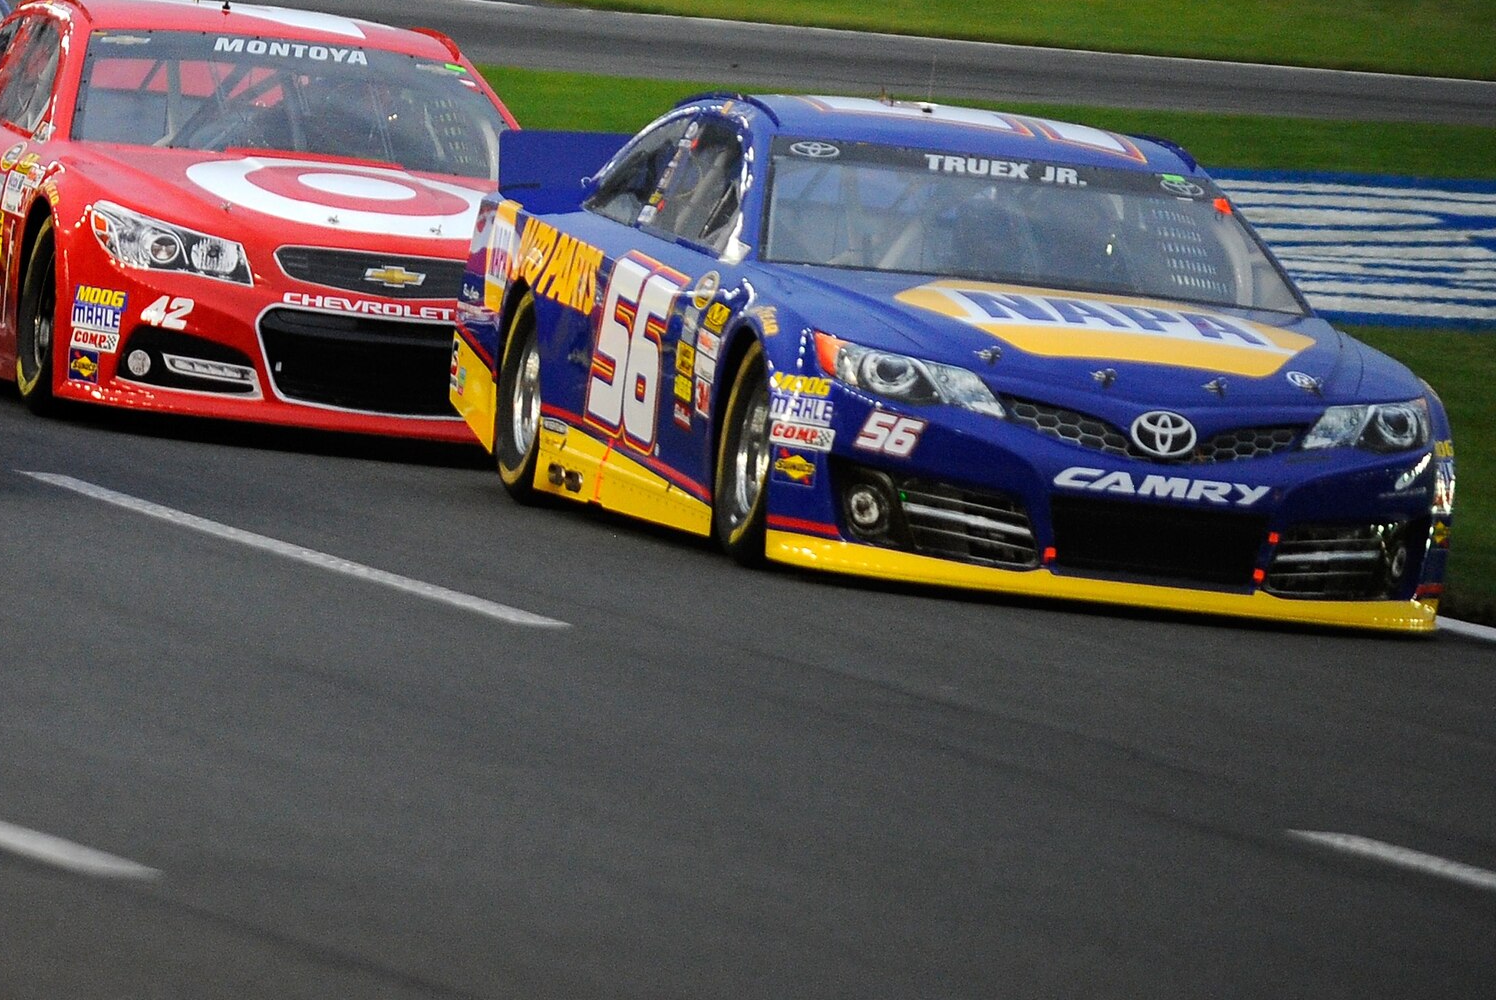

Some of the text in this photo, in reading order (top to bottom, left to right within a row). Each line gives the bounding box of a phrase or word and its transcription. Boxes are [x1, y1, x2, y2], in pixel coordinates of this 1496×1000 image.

[214, 37, 368, 65] MONTOYA
[925, 153, 1087, 186] TRUEX JR.
[75, 285, 126, 308] MOOG
[283, 292, 454, 321] CHEVROLET
[72, 304, 121, 328] MAHLE
[140, 295, 195, 330] 42
[957, 290, 1265, 346] NAPA
[74, 330, 107, 347] COMP
[587, 253, 685, 450] 56
[770, 371, 832, 397] MOOG
[772, 423, 819, 443] COMP
[854, 409, 927, 458] 56
[1053, 466, 1271, 505] CAMRY
